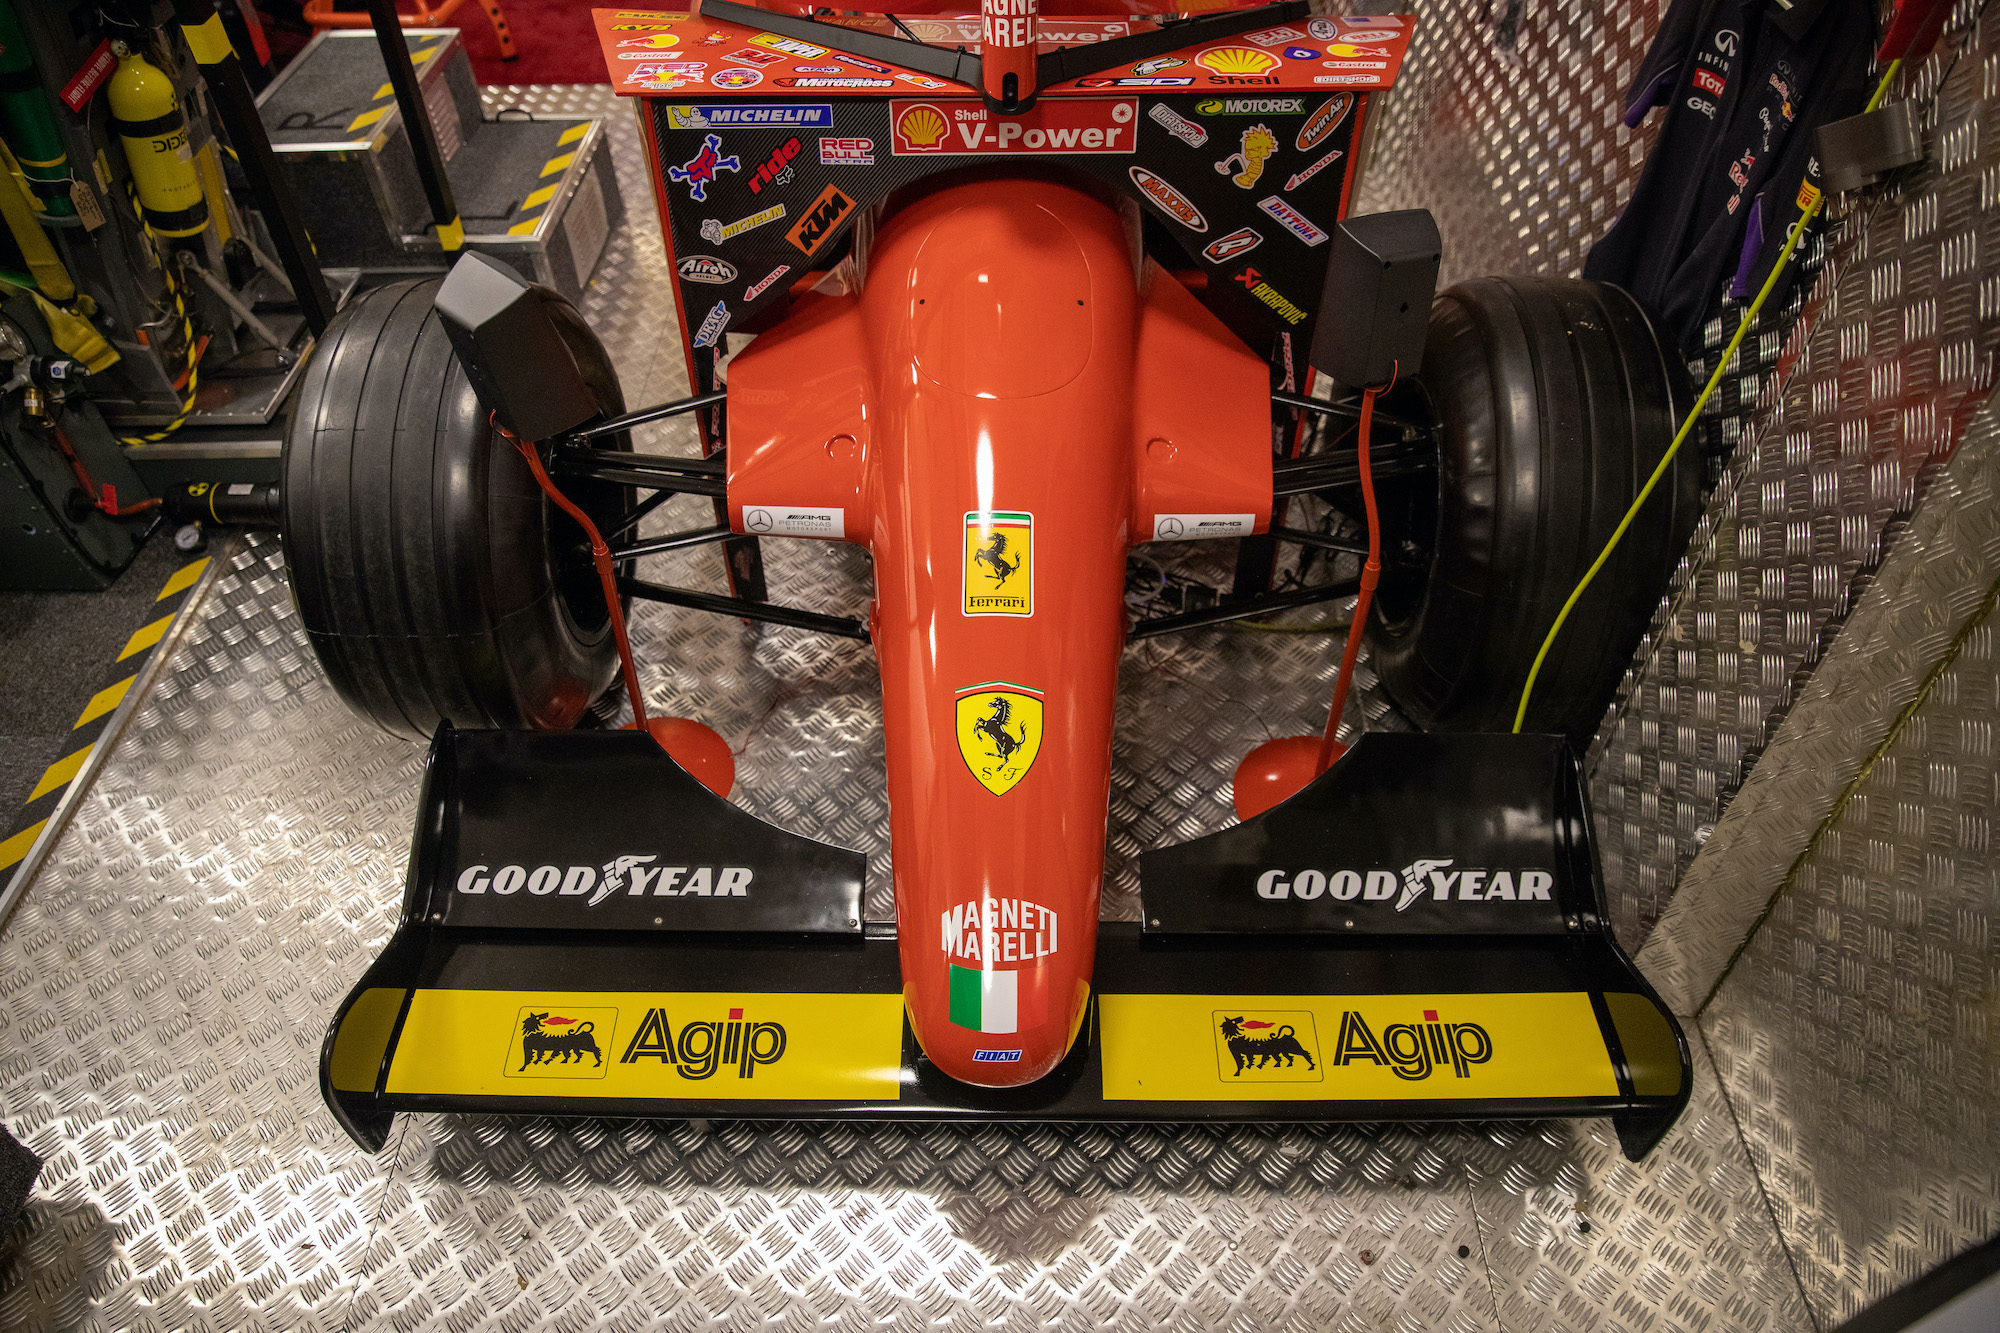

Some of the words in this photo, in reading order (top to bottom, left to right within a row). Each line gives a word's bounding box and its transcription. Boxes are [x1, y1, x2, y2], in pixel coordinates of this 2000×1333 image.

[1208, 76, 1280, 84] Shell
[710, 109, 822, 122] MICHELIN
[955, 109, 988, 121] Shell
[1225, 98, 1303, 114] MOTOREX
[1303, 113, 1331, 142] Twin
[1330, 98, 1344, 118] Air
[957, 122, 1123, 150] V-Power
[1156, 109, 1202, 142] DIRTSHOP
[821, 139, 873, 150] RED
[822, 151, 873, 159] BULL
[748, 137, 802, 195] ride
[1297, 151, 1339, 182] HONDA
[1141, 177, 1197, 222] MAXXIS
[721, 205, 784, 239] MICHELIN
[798, 192, 849, 251] KTM
[1267, 202, 1318, 241] DAYTONA
[680, 259, 732, 278] Airoh
[754, 265, 789, 293] HONDA
[697, 309, 725, 341] DRAG
[778, 520, 832, 528] PETRONAS
[969, 596, 1025, 608] Ferrari
[982, 766, 993, 780] S
[941, 898, 1058, 931] MAGNETI
[941, 930, 1058, 962] MARELLI
[619, 1007, 787, 1080] Agip
[976, 1051, 1018, 1061] FIAT
[1333, 1009, 1493, 1081] Agip
